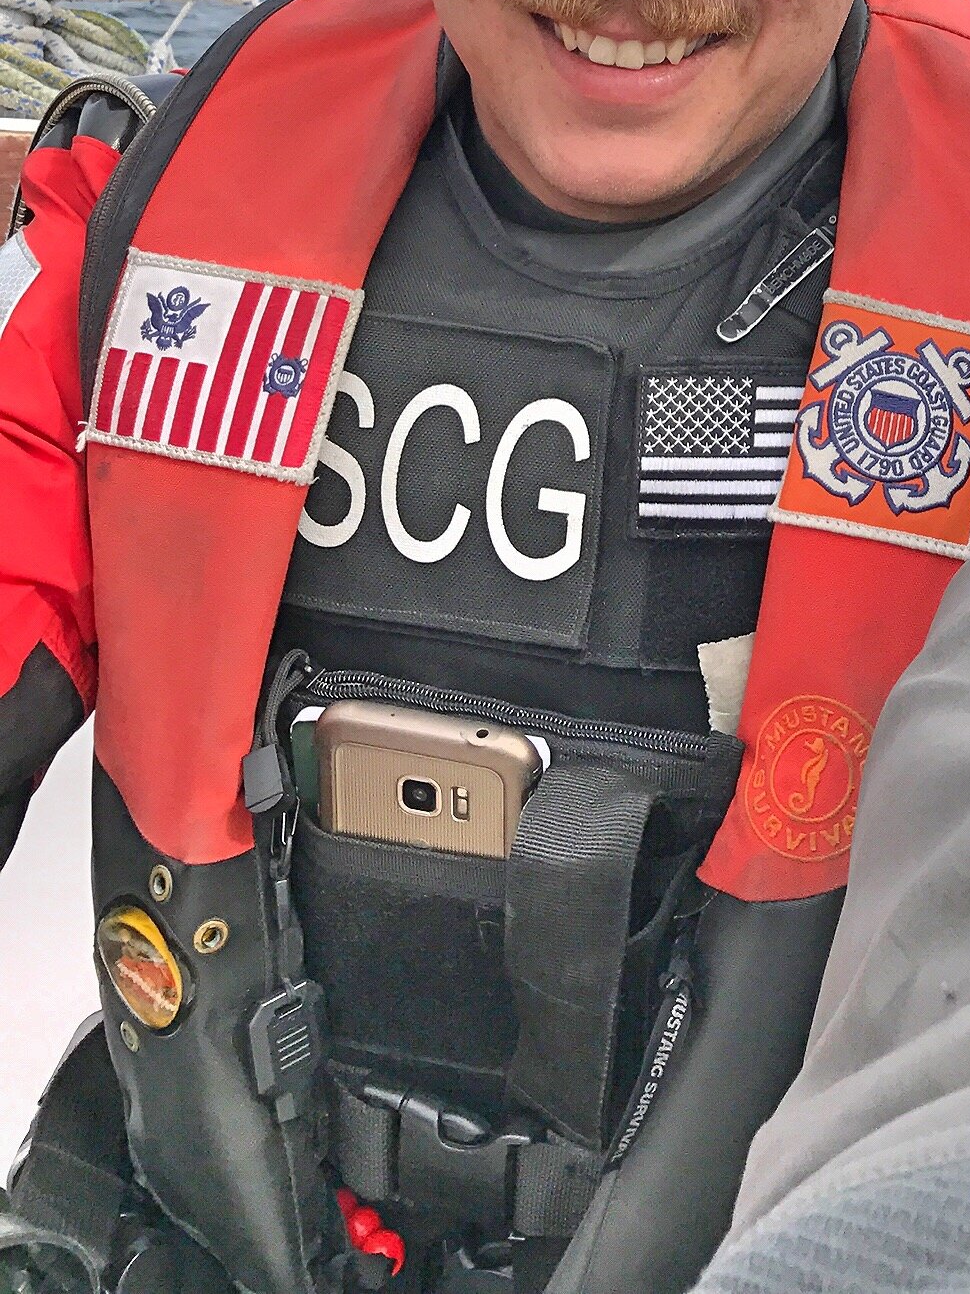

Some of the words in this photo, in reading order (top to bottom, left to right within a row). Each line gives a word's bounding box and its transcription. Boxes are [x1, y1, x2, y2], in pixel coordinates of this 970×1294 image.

[845, 357, 907, 392] STATES
[906, 362, 948, 412] COAST
[833, 389, 861, 454] UNITED
[908, 414, 949, 471] GUARD
[856, 449, 905, 477] 1790
[763, 705, 868, 769] MUSTAN
[752, 768, 857, 852] SURVIVA
